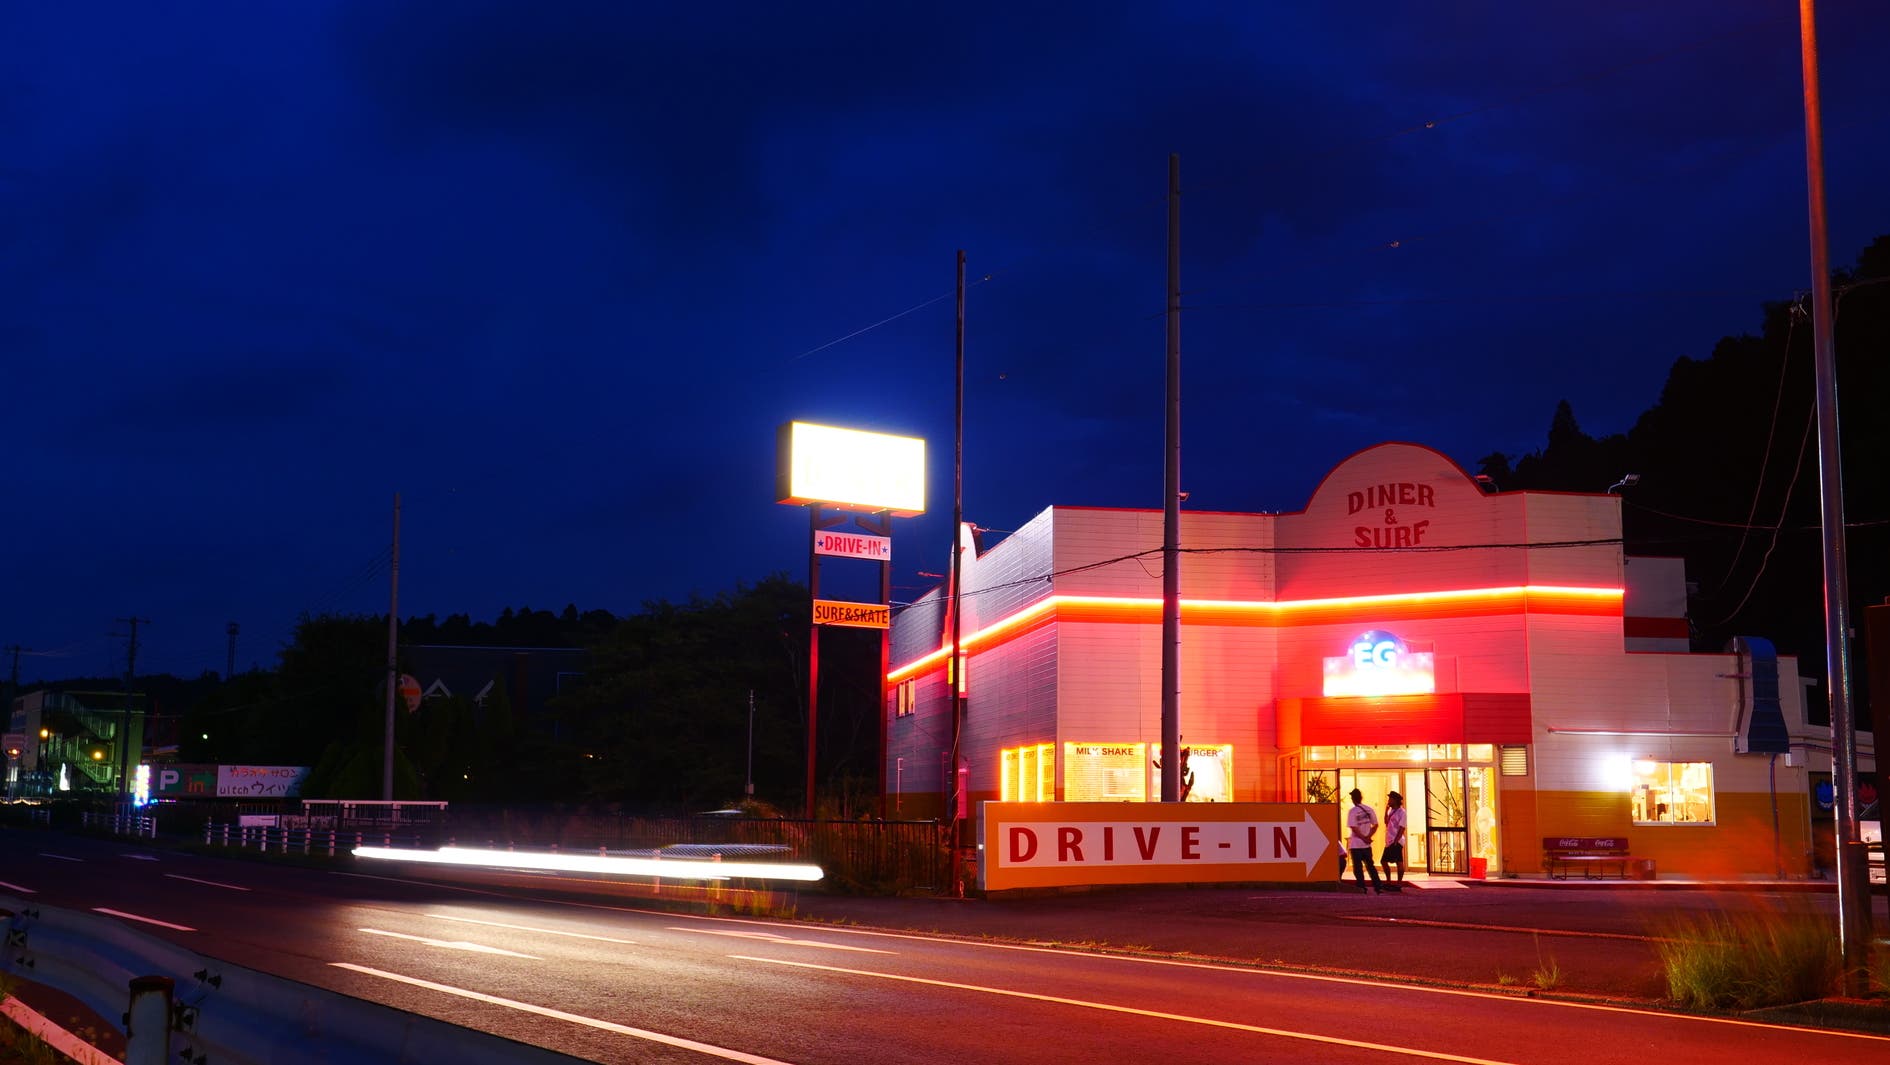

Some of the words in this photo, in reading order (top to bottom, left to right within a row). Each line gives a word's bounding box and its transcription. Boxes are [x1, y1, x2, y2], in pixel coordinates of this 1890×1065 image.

[1347, 482, 1435, 515] DINER
[1384, 508, 1398, 525] &
[1354, 520, 1429, 548] SURF
[824, 535, 882, 556] DRIVE-IN
[815, 604, 888, 624] SURF&SKATE
[1354, 641, 1396, 669] EG
[1102, 747, 1134, 756] SHAKE
[159, 769, 180, 791] P
[1009, 826, 1297, 863] DRIVE-IN
